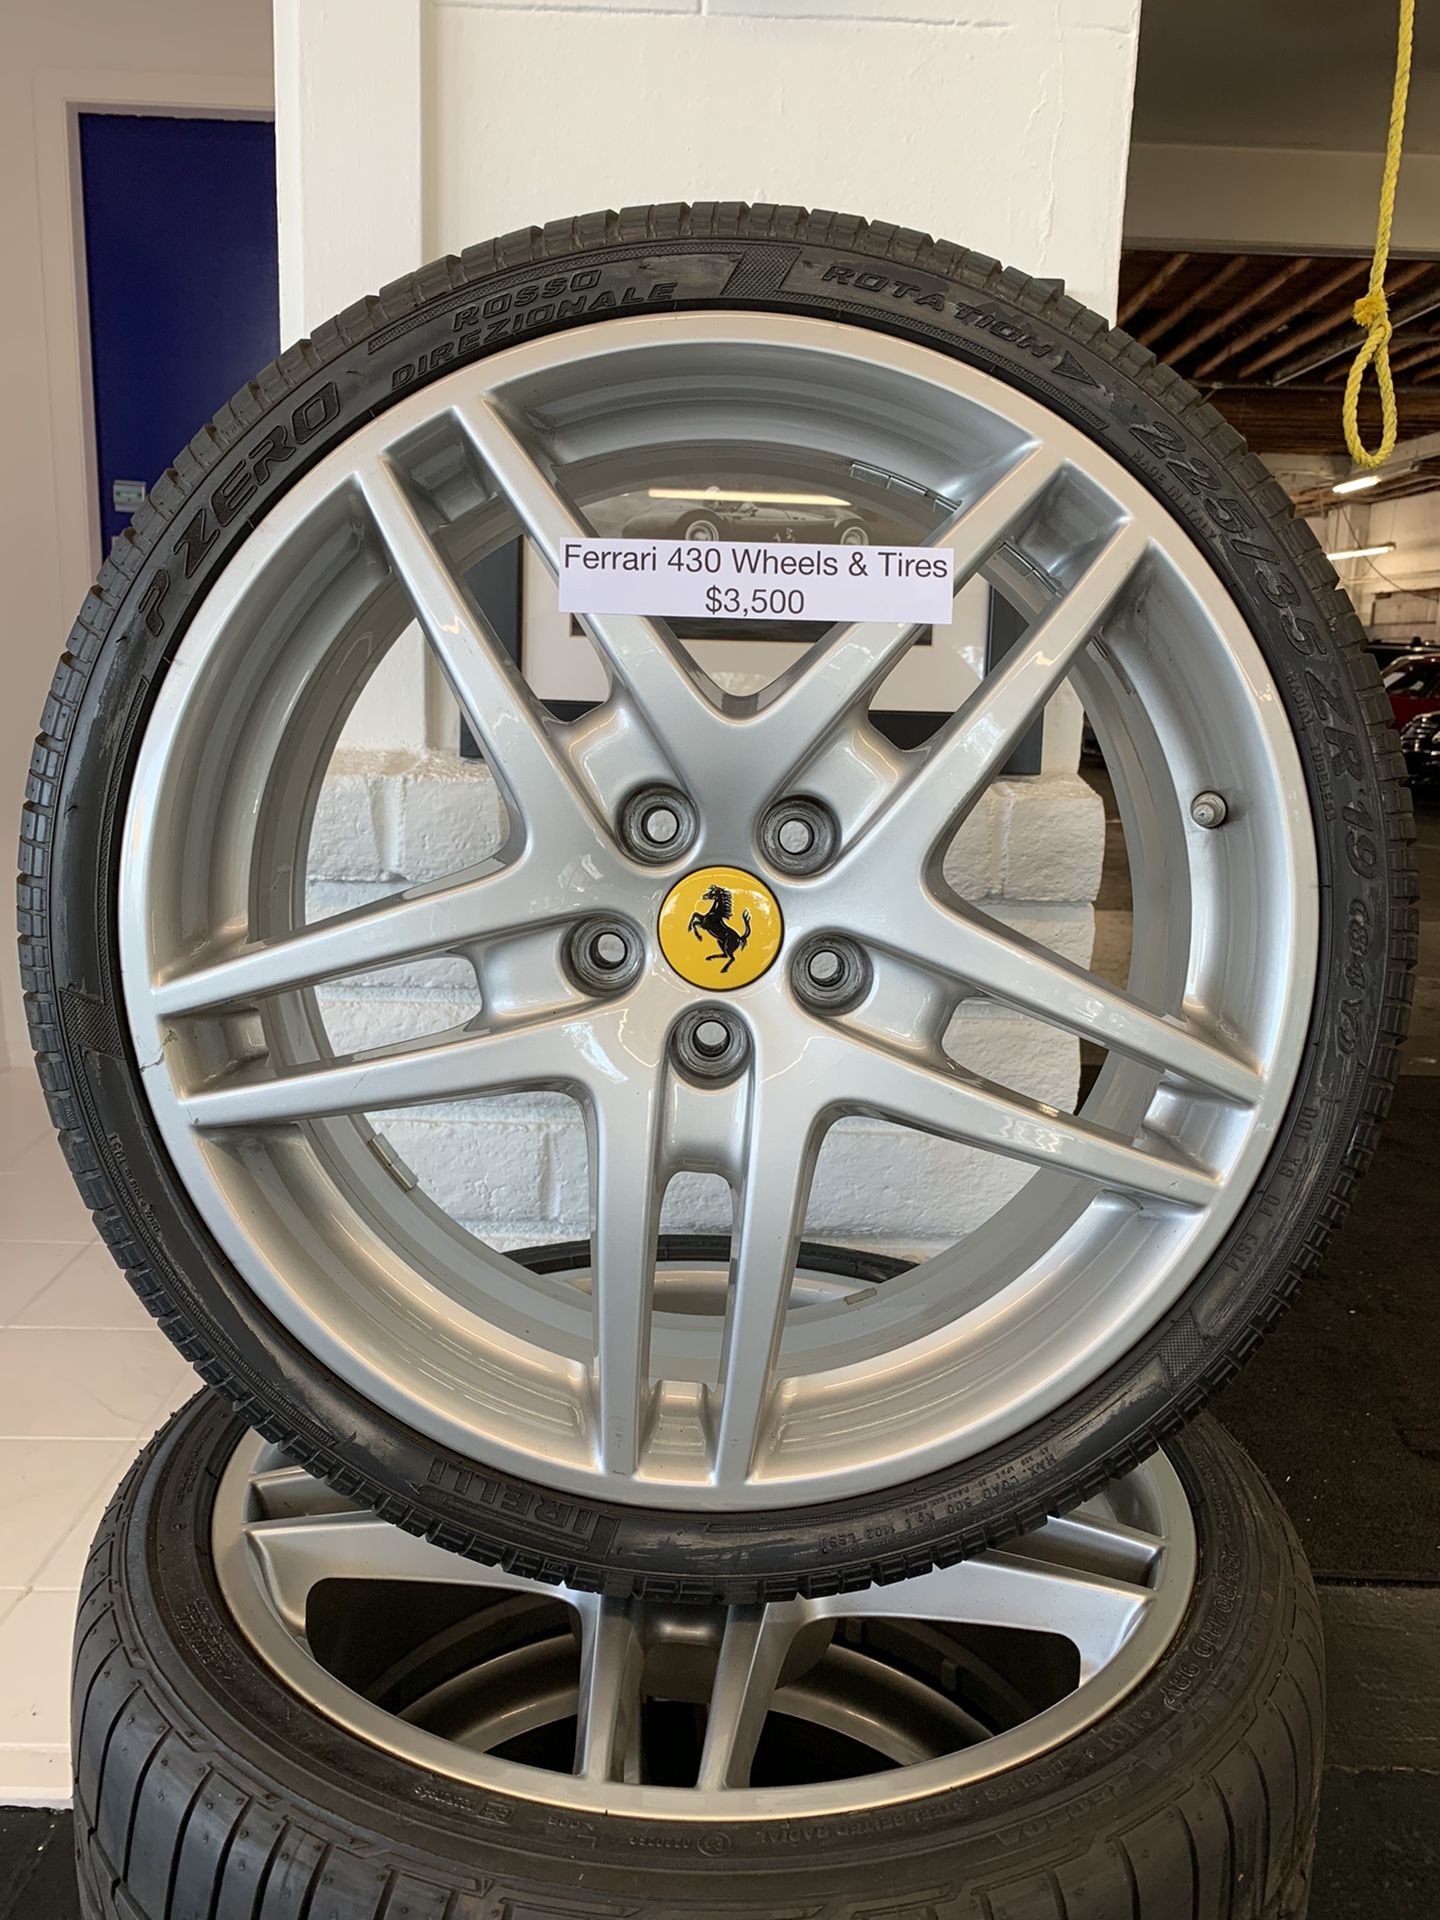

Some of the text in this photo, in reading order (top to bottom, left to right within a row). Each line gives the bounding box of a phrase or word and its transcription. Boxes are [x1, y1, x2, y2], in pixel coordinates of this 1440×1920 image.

[391, 281, 678, 391] DIREZIONALE
[452, 269, 601, 331] ROSSO
[821, 264, 1056, 359] ROTATION
[138, 381, 341, 638] P ZERO
[564, 544, 949, 579] Ferrari 430 Wheels & Tires
[705, 584, 806, 617] $3,500
[424, 1455, 621, 1562] PIRELLI
